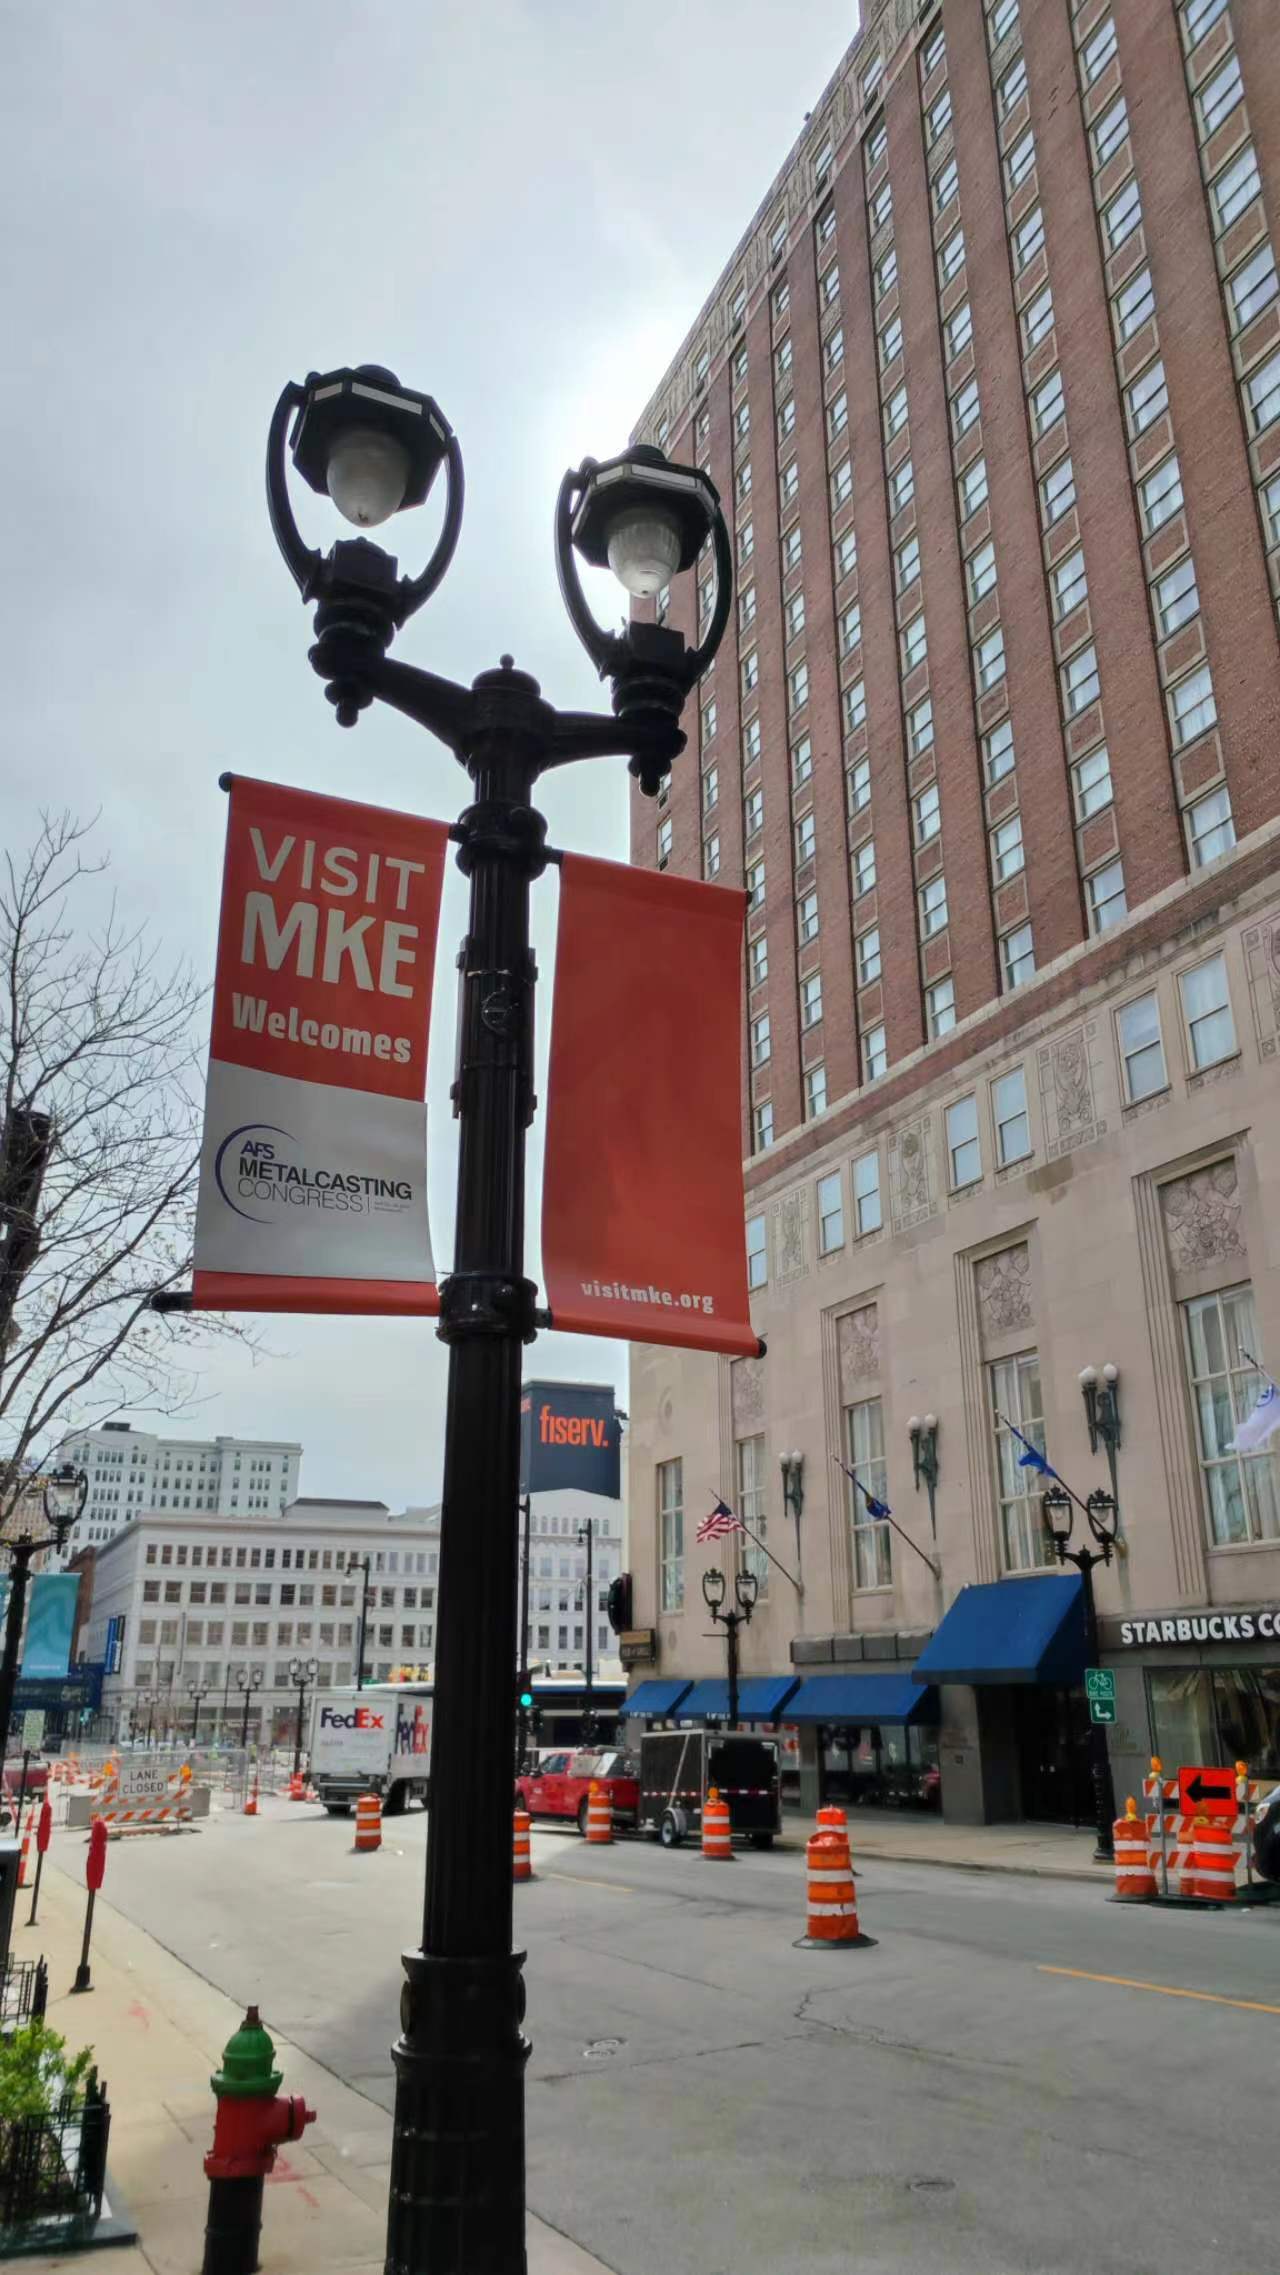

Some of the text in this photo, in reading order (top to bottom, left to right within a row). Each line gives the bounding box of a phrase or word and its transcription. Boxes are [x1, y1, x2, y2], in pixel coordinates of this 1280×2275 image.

[249, 827, 426, 911] VISIT
[241, 891, 419, 999] MKE
[232, 992, 412, 1063] Welcomes
[240, 1140, 275, 1160] AFS
[237, 1177, 364, 1213] CONGRESS
[239, 1156, 412, 1200] METALCASTING
[580, 1280, 714, 1315] visitmke.org
[1120, 1613, 1256, 1645] STARBUCKS
[320, 1707, 384, 1729] FedEx
[123, 1782, 164, 1794] CLOSED
[130, 1769, 159, 1781] LANE
